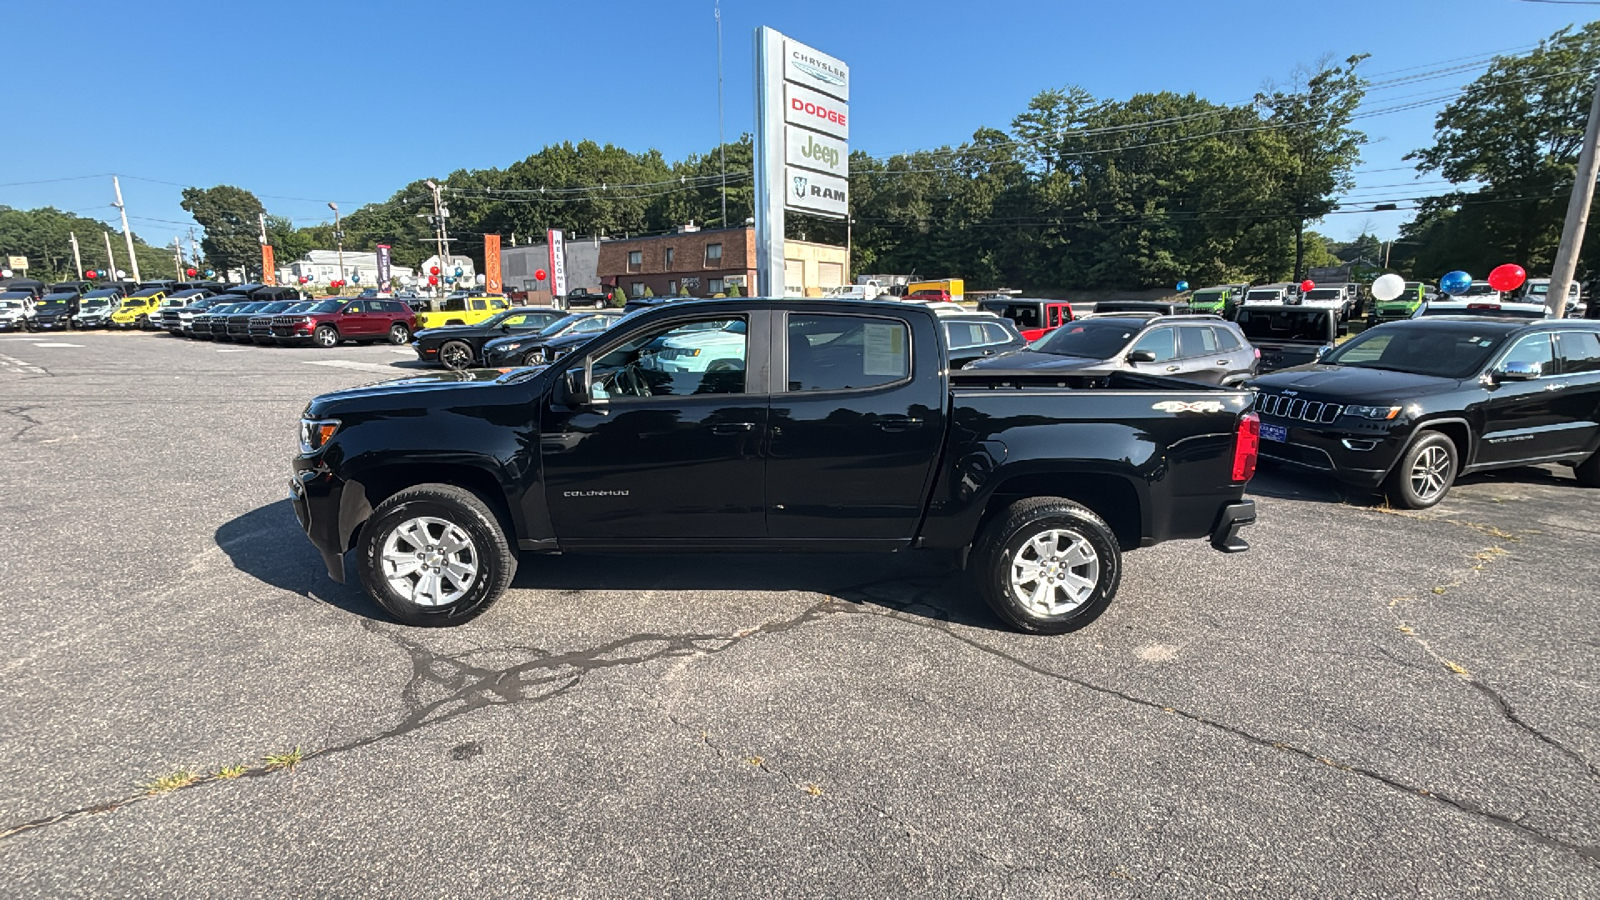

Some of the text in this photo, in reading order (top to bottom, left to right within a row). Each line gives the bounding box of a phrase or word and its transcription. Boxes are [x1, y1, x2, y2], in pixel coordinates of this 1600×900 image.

[792, 51, 846, 79] CHRYSLER
[791, 97, 846, 127] DODGE
[801, 135, 839, 169] Jeep
[810, 184, 846, 203] RAM
[554, 239, 564, 289] WELCOME
